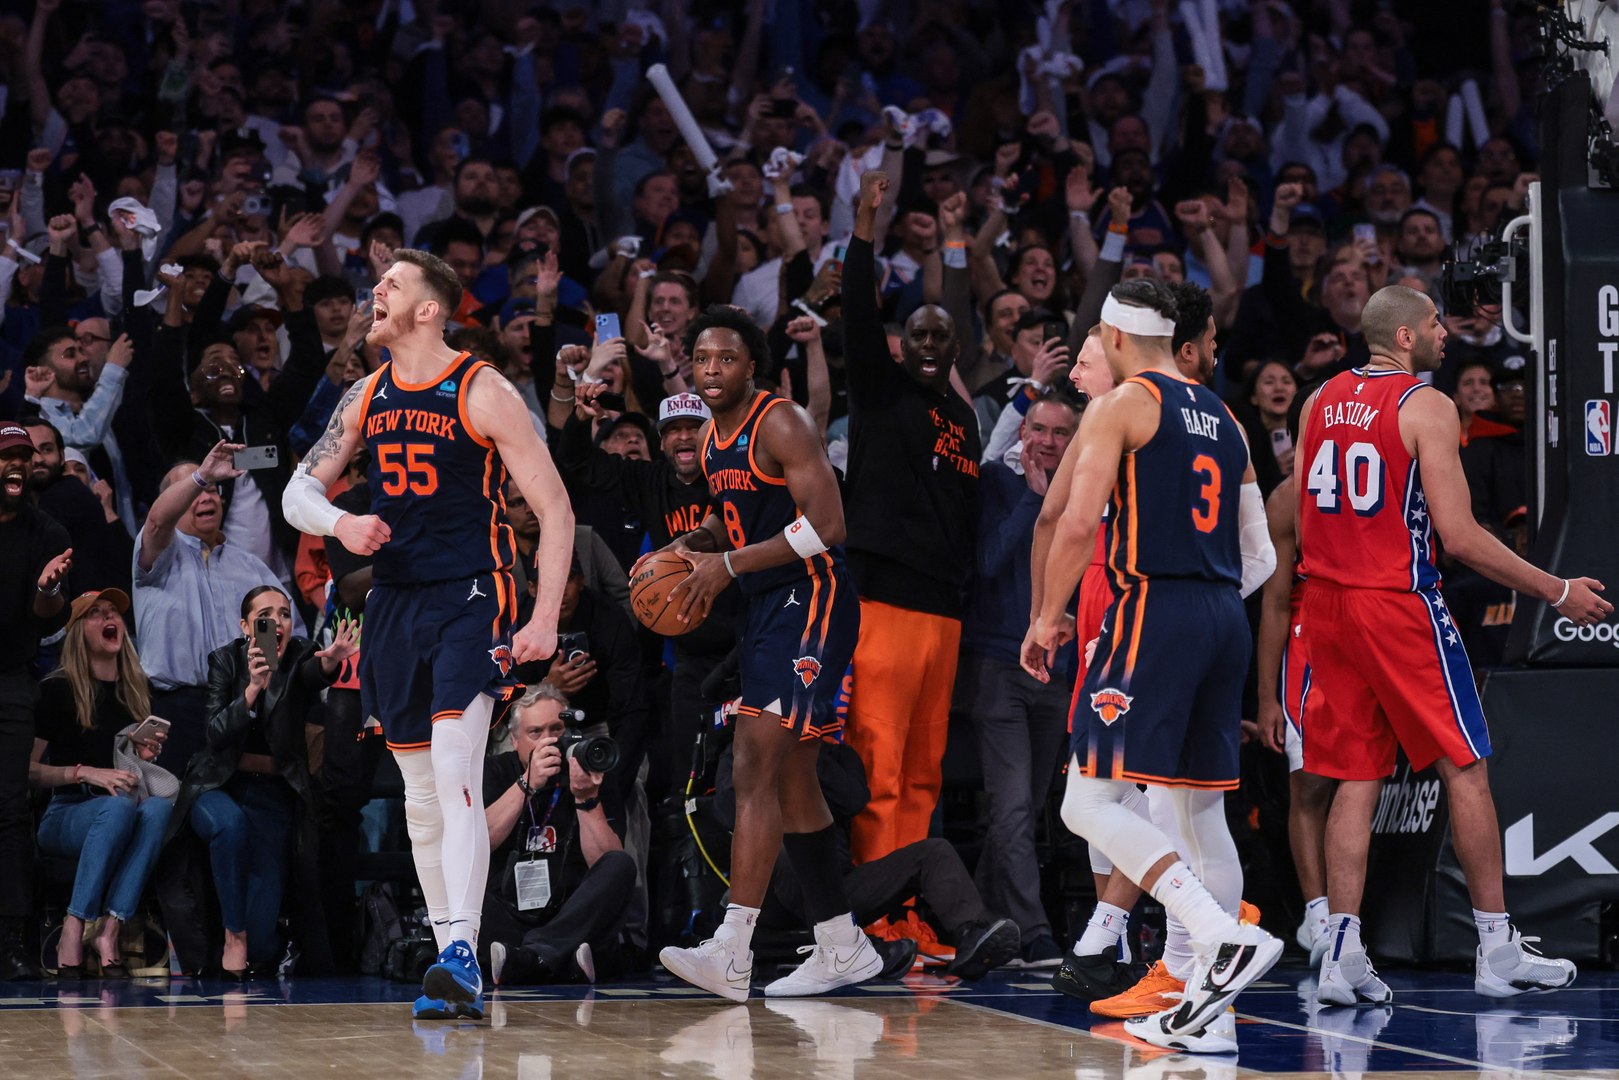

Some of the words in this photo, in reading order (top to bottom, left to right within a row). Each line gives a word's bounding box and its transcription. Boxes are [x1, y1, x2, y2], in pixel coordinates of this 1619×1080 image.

[667, 400, 702, 413] KNICKS
[1324, 401, 1379, 431] BATUM
[366, 409, 402, 438] NEW
[404, 409, 456, 441] YORK
[1181, 407, 1220, 441] HART
[377, 443, 438, 497] 55
[721, 468, 758, 491] YORK
[1308, 439, 1386, 517] 40
[1192, 453, 1222, 534] 3
[723, 500, 746, 550] 8
[790, 522, 802, 533] 8
[1094, 693, 1128, 710] KNICKS
